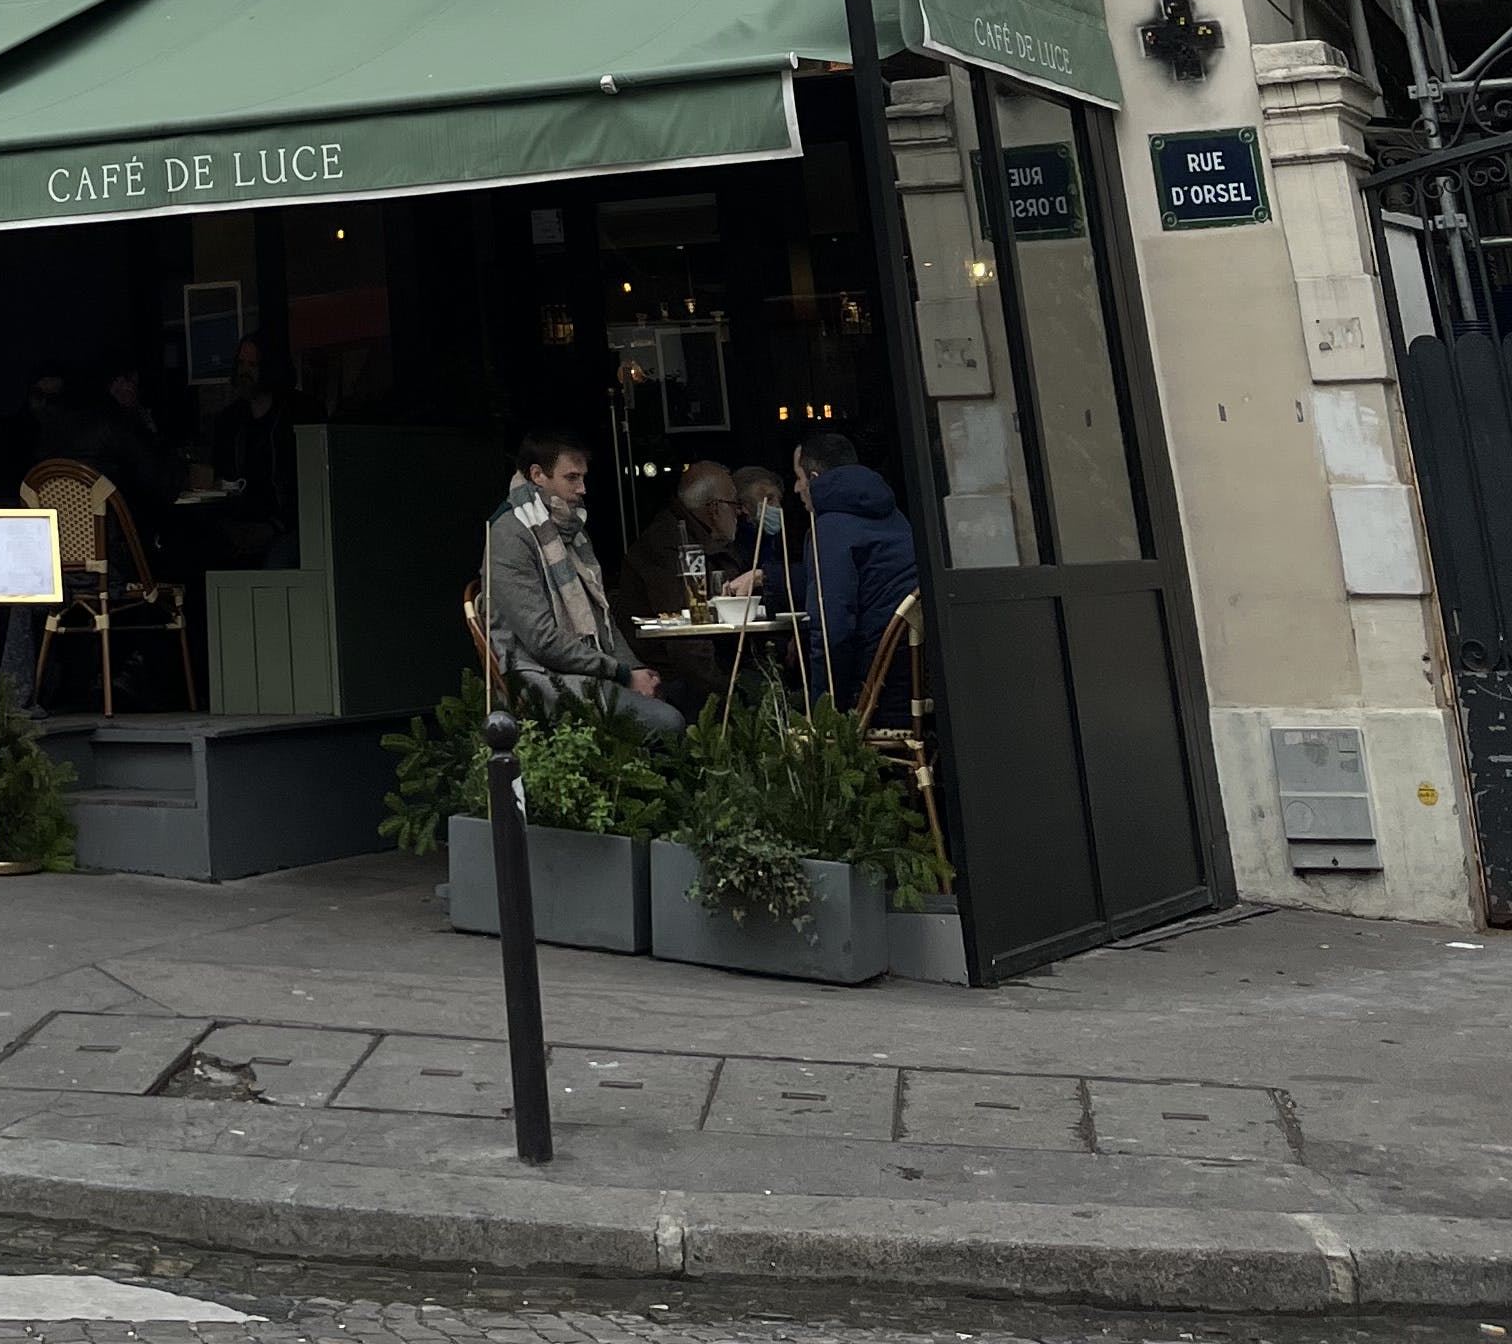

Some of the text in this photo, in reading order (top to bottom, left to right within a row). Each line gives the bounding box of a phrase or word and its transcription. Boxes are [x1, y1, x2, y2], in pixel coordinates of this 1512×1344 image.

[974, 17, 1073, 75] CAFÉ DE LUCE
[48, 143, 344, 203] CAFÉ DE LUCE
[1186, 151, 1226, 174] RUE
[1171, 182, 1252, 206] D'ORSEL
